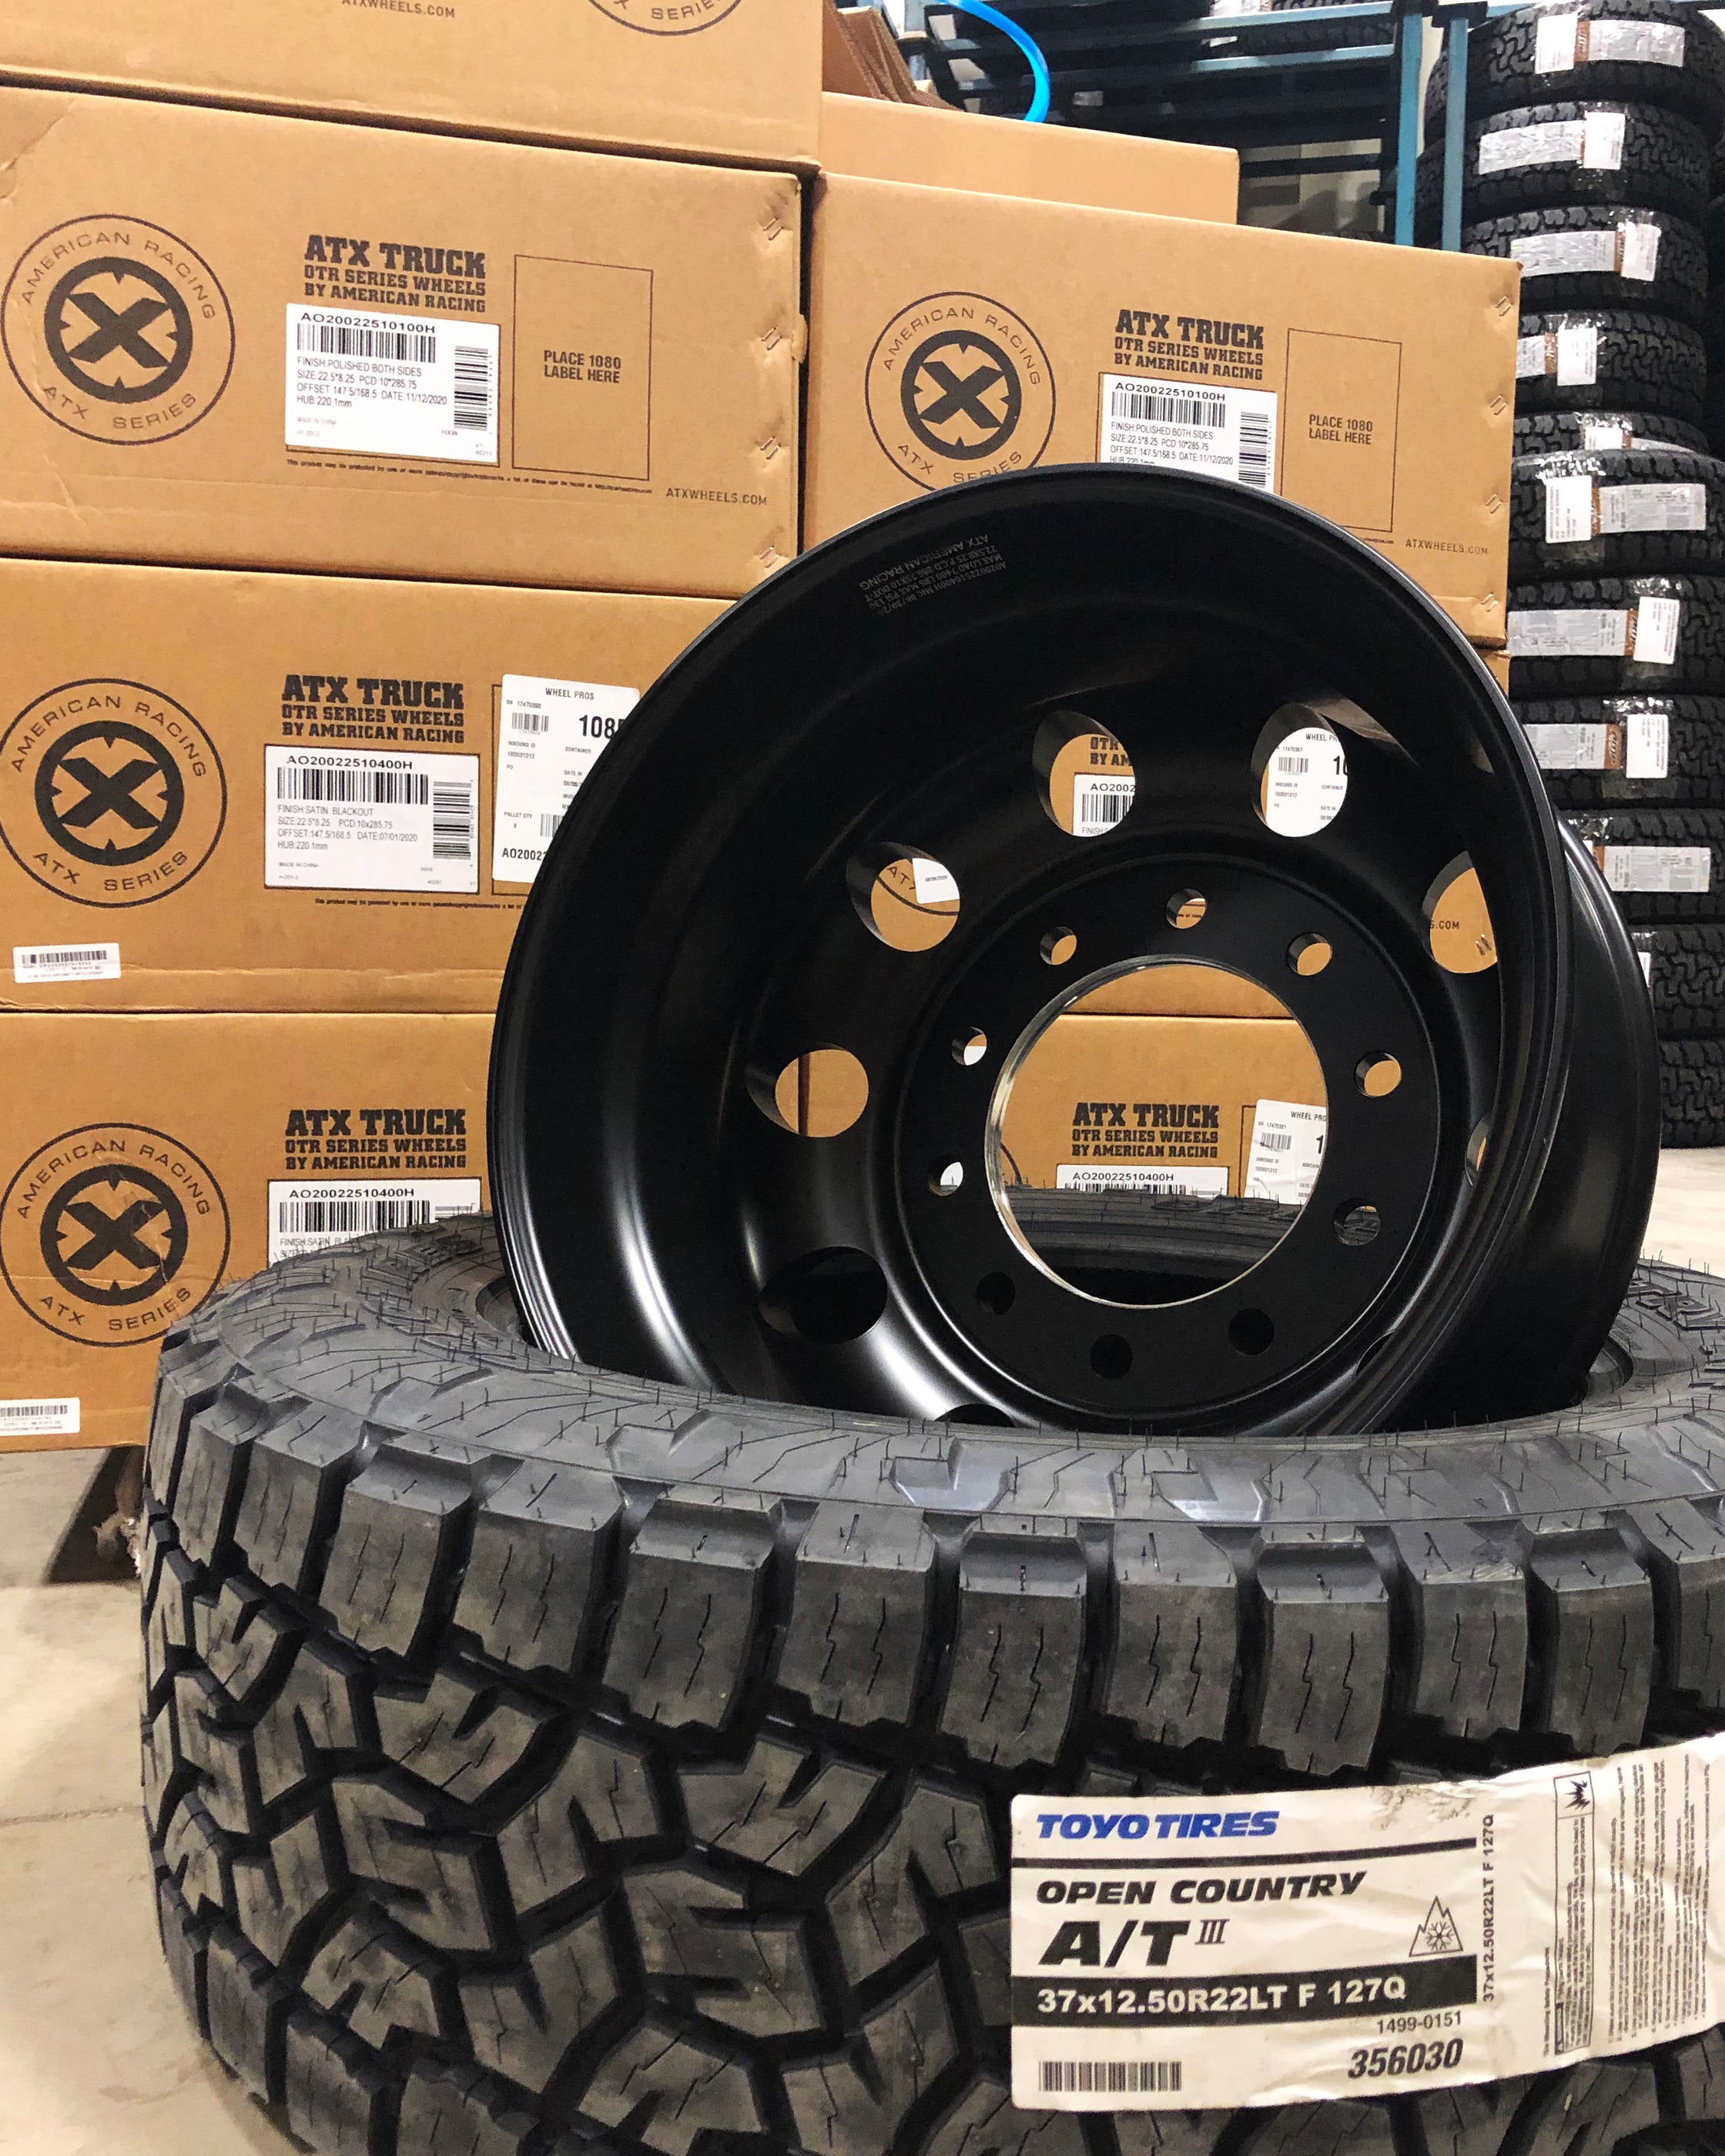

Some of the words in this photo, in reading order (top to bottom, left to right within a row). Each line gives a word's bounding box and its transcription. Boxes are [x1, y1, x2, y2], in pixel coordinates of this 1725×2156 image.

[651, 0, 716, 20] SERIE
[304, 234, 370, 267] ATX
[379, 242, 486, 280] TRUCK
[22, 232, 130, 304] AMERICAN
[145, 239, 216, 320] RACING
[304, 264, 340, 282] OTR
[345, 269, 408, 290] SERIES
[414, 276, 486, 296] WHEELS
[304, 283, 326, 296] BY
[330, 285, 420, 307] AMERICAN
[425, 294, 486, 313] RACING
[1115, 309, 1170, 339] ATX
[1177, 316, 1264, 350] TRUCK
[883, 307, 975, 371] AMERICAN
[985, 314, 1041, 385] RACING
[1114, 336, 1144, 352] OTR
[1147, 340, 1199, 359] SERIES
[1204, 347, 1263, 366] WHEELS
[372, 363, 395, 375] BOTH
[397, 366, 422, 377] SIDES
[544, 350, 584, 366] PLACE
[590, 354, 621, 370] 1080
[1114, 353, 1132, 365] BY
[1135, 355, 1208, 375] AMERICAN
[1213, 363, 1263, 380] RACING
[544, 364, 583, 380] LABEL
[588, 369, 620, 383] HERE
[43, 387, 89, 420] ATX
[113, 393, 196, 430] SERIES
[1172, 427, 1191, 438] BOTH
[1193, 430, 1214, 440] SIDES
[1309, 414, 1343, 429] PLACE
[1348, 419, 1373, 432] 1080
[1309, 428, 1341, 442] LABEL
[1345, 431, 1372, 445] HERE
[898, 444, 934, 475] ATX
[666, 487, 767, 505] ATXWHEELS.COM
[964, 534, 990, 548] ATX
[1405, 539, 1488, 555] ATXWHEELS.COM
[904, 541, 965, 571] AMERICAN
[859, 565, 904, 591] RACING
[282, 675, 348, 704] ATX
[357, 678, 464, 710] TRUCK
[545, 687, 571, 698] WHEEL
[574, 691, 595, 700] PROS
[282, 704, 317, 720] OTR
[323, 706, 386, 723] SERIES
[391, 709, 464, 727] WHEELS
[579, 715, 626, 739] 108
[12, 695, 121, 772] AMERICAN
[135, 701, 206, 777] RACING
[282, 721, 304, 736] BY
[308, 723, 398, 741] AMERICAN
[403, 728, 464, 744] RACING
[1306, 733, 1327, 742] WHEEL
[1090, 752, 1107, 765] BY
[332, 807, 373, 816] BLACKOUT
[33, 852, 80, 885] ATX
[103, 851, 188, 891] SERIES
[285, 1110, 351, 1137] ATX
[360, 1109, 467, 1136] TRUCK
[1072, 1102, 1126, 1127] ATX
[1133, 1103, 1219, 1128] TRUCK
[1291, 1110, 1311, 1121] WHEEL
[285, 1139, 320, 1153] OTR
[326, 1138, 389, 1153] SERIES
[394, 1138, 467, 1153] WHEELS
[1072, 1129, 1100, 1142] OTR
[1104, 1130, 1155, 1143] SERIES
[1159, 1130, 1218, 1143] WHEELS
[286, 1157, 307, 1170] BY
[312, 1156, 400, 1170] AMERICAN
[406, 1155, 467, 1169] RACING
[1072, 1144, 1090, 1157] BY
[1093, 1145, 1164, 1157] AMERICAN
[1168, 1146, 1218, 1158] RACING
[18, 1140, 126, 1219] AMERICAN
[140, 1144, 209, 1215] RACING
[41, 1296, 85, 1325] ATX
[109, 1287, 191, 1331] SERIES
[1037, 1813, 1150, 1840] TOYO
[1154, 1811, 1281, 1840] TIRES
[1482, 1814, 1494, 1856] 127Q
[1482, 1862, 1494, 1871] F
[1037, 1880, 1157, 1905] OPEN
[1170, 1871, 1368, 1905] COUNTRY
[1038, 1920, 1191, 1969] A/T
[1195, 1919, 1231, 1945] III
[1482, 1877, 1494, 2002] 37x12.50R22LT
[1038, 1984, 1288, 2014] 37x12.50R22LT
[1299, 1984, 1316, 2007] F
[1328, 1975, 1408, 2006] 127Q
[1376, 2010, 1463, 2035] 1499-0151
[1348, 2038, 1465, 2080] 356030
